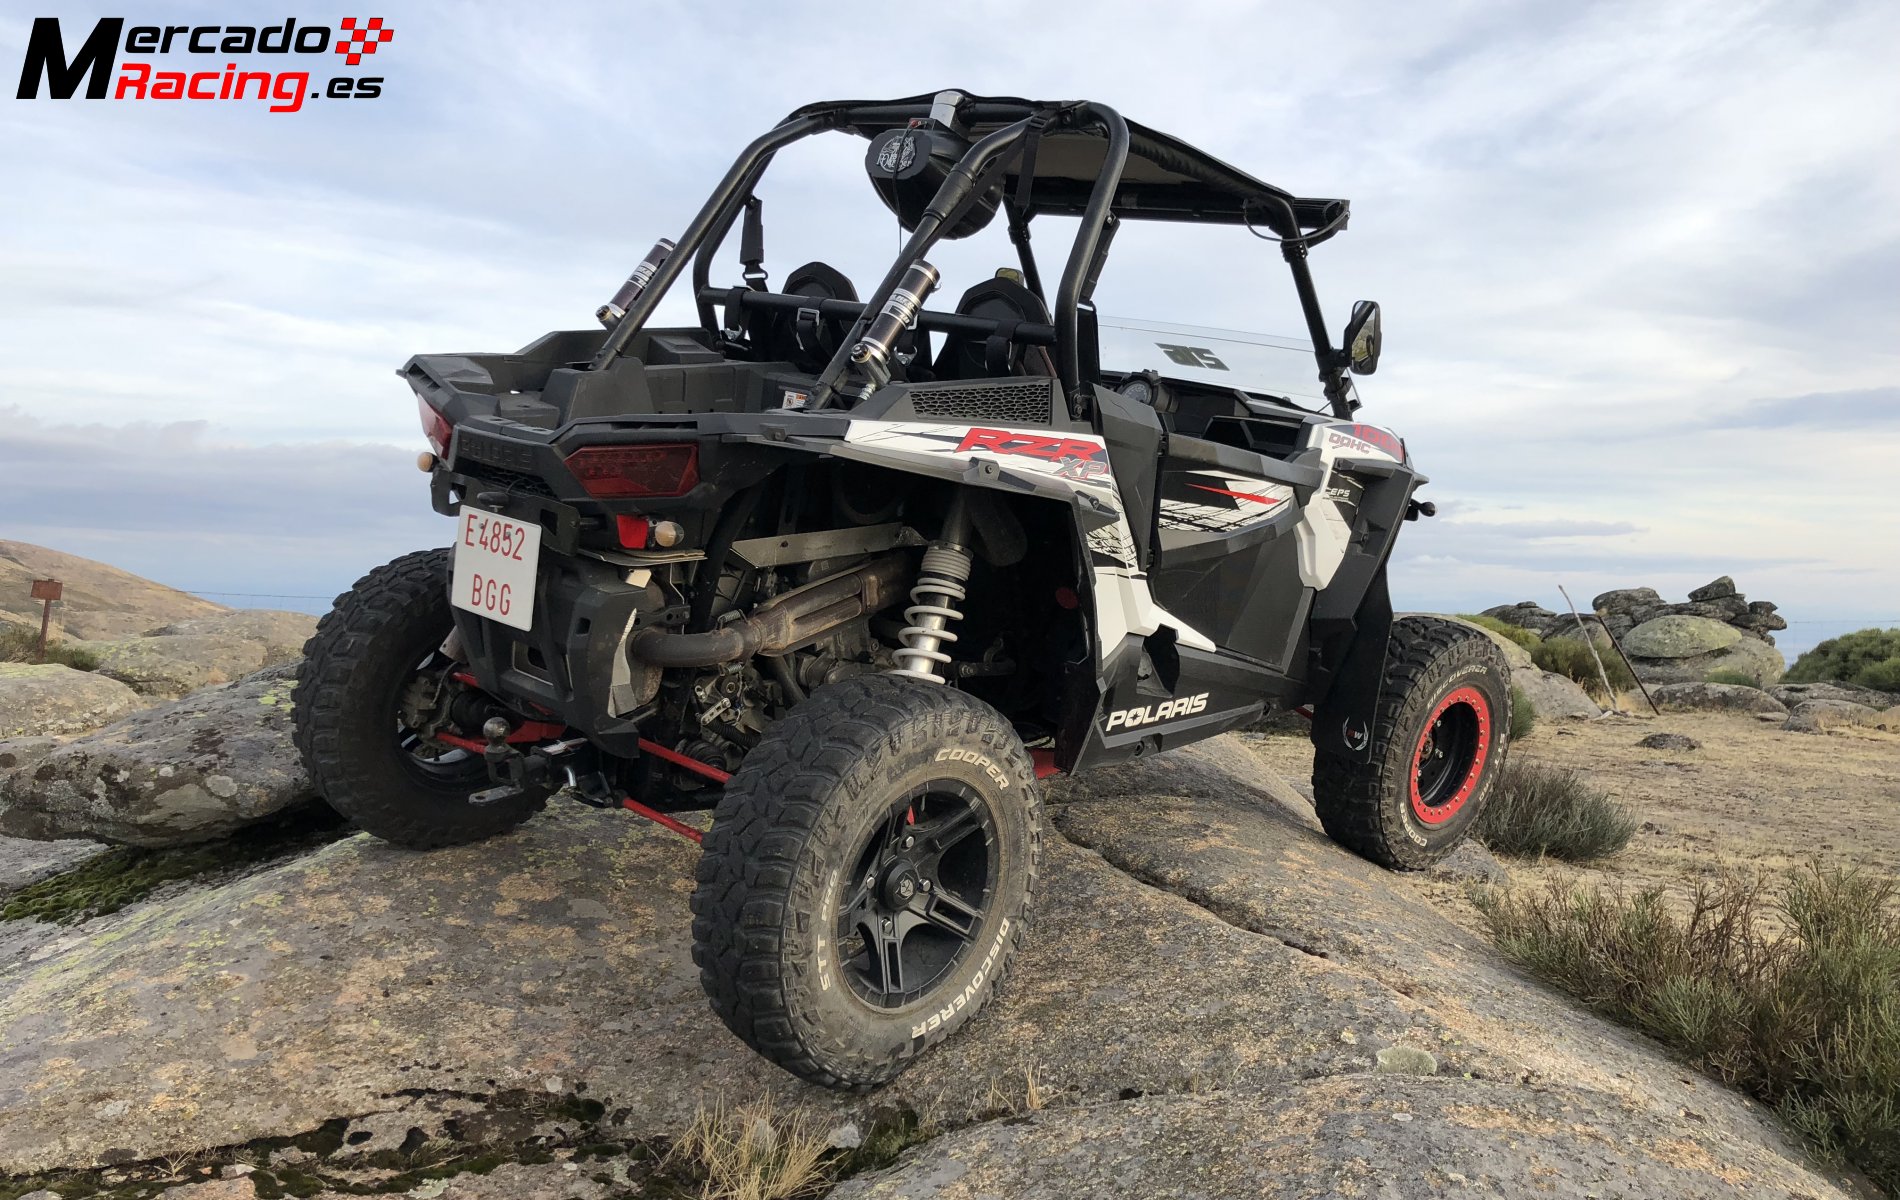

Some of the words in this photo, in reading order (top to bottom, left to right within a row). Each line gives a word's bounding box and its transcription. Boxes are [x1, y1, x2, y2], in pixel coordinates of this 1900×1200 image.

[954, 427, 1104, 461] RZR
[1328, 432, 1371, 454] DOHC
[1053, 457, 1110, 480] XP
[1330, 487, 1351, 497] EPS
[464, 513, 526, 561] E4852
[471, 573, 512, 616] BGG
[1105, 692, 1209, 732] POLARIS
[934, 749, 1010, 791] COOPER
[817, 934, 832, 992] STT
[911, 917, 1010, 1039] DISCOVERER
